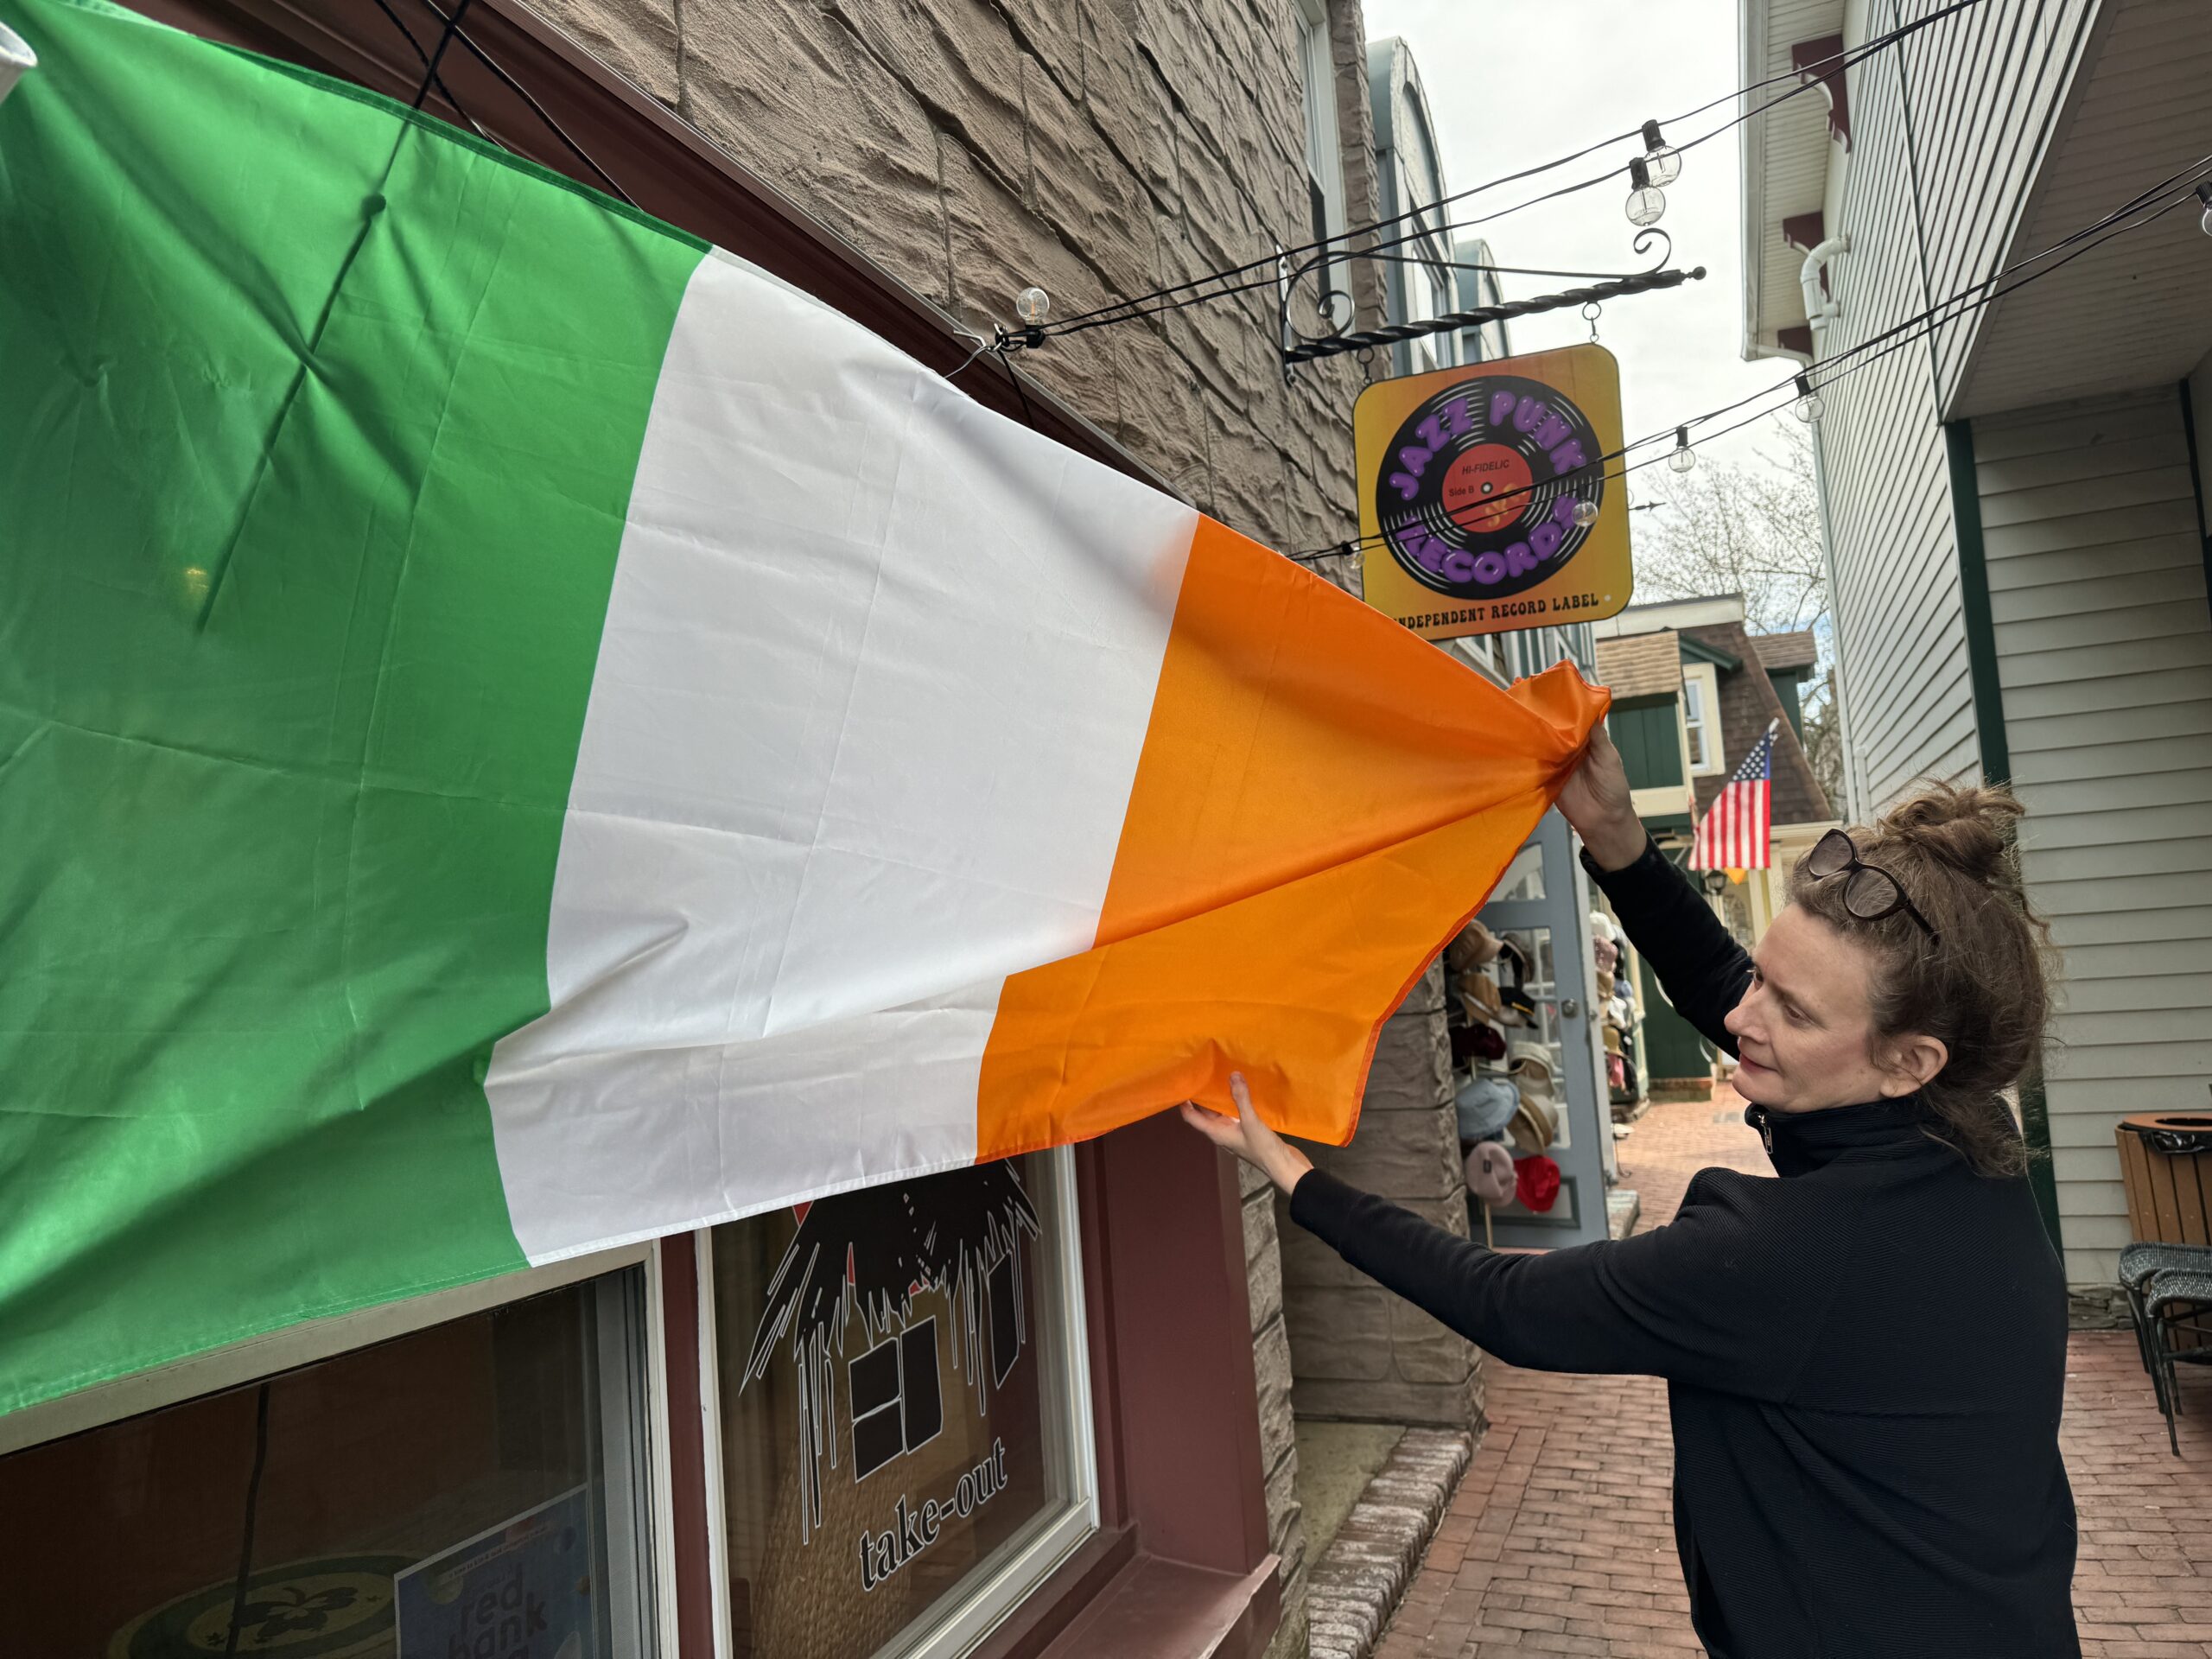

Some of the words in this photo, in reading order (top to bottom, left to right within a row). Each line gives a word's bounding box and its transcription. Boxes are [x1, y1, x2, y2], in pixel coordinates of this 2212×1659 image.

[1389, 397, 1473, 500] JAZZ
[1489, 391, 1587, 475] PUNK
[1462, 459, 1510, 475] HI-FIDELIC
[1448, 487, 1466, 497] Side
[1468, 485, 1475, 493] B
[1395, 494, 1583, 585] RECORDS
[1393, 607, 1485, 630] NDEPENDENT
[1491, 601, 1547, 619] RECORD
[1553, 593, 1599, 612] LABEL
[859, 1436, 1008, 1592] take-out
[460, 1561, 523, 1643] red
